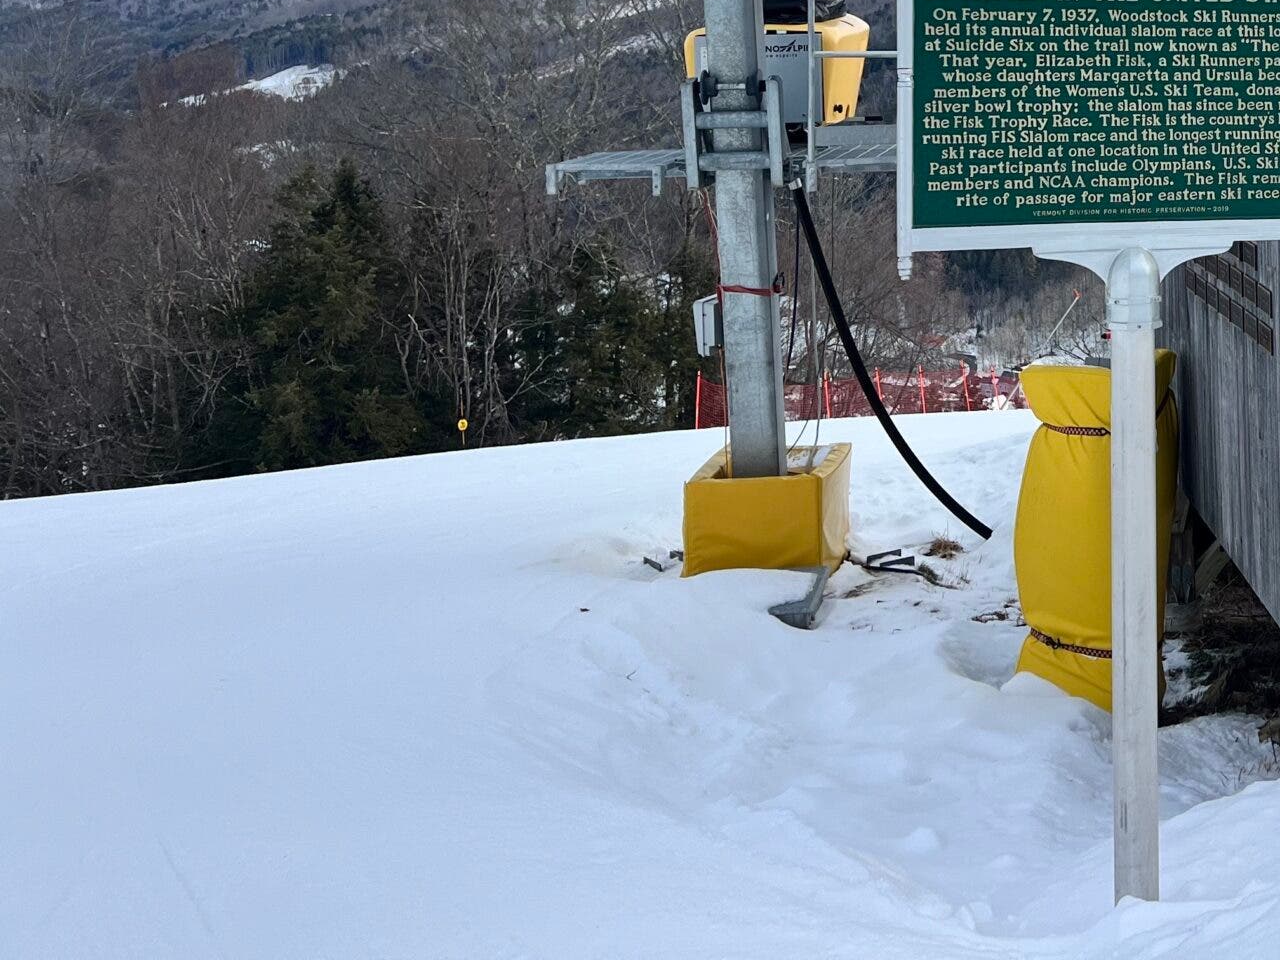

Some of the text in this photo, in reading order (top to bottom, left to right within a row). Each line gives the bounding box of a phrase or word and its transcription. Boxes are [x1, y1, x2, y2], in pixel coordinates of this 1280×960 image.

[933, 8, 956, 20] On
[961, 8, 1036, 24] February
[1042, 8, 1055, 22] 7,
[1061, 8, 1099, 23] 1937,
[1108, 9, 1188, 22] Woodstock
[1193, 9, 1216, 22] Ski
[1221, 10, 1280, 23] Runners
[924, 22, 960, 35] held
[965, 23, 986, 35] its
[991, 23, 1044, 36] annual
[1049, 23, 1126, 36] individual
[1131, 24, 1176, 37] slalom
[1181, 27, 1212, 36] race
[1217, 24, 1231, 36] at
[1237, 24, 1264, 37] this
[924, 38, 940, 50] at
[946, 38, 1004, 51] Suicide
[1009, 38, 1034, 51] Six
[1039, 42, 1057, 51] on
[1063, 38, 1088, 51] the
[1094, 38, 1129, 51] trail
[1134, 42, 1163, 51] now
[1169, 39, 1217, 51] known
[1222, 42, 1236, 51] as
[939, 53, 978, 66] That
[984, 57, 1026, 69] year,
[1035, 53, 1111, 66] Elizabeth
[1116, 54, 1151, 67] Fisk,
[1158, 57, 1166, 66] a
[1172, 54, 1195, 66] Ski
[1200, 54, 1259, 66] Runners
[942, 69, 991, 81] whose
[996, 68, 1075, 84] daughters
[1080, 68, 1168, 84] Margaretta
[1173, 68, 1201, 81] and
[1206, 68, 1252, 80] Ursula
[934, 85, 1006, 98] members
[1011, 84, 1028, 97] of
[1034, 84, 1060, 97] the
[1129, 84, 1157, 96] U.S.
[1164, 83, 1187, 96] Ski
[1193, 83, 1238, 97] Team,
[924, 99, 969, 112] silver
[974, 99, 1011, 112] bowl
[1087, 99, 1113, 111] the
[1117, 99, 1163, 111] slalom
[1167, 98, 1192, 111] has
[1195, 98, 1233, 111] since
[1237, 98, 1273, 110] been
[922, 115, 949, 128] the
[953, 115, 984, 128] Fisk
[988, 114, 1048, 131] Trophy
[1052, 113, 1092, 127] Race.
[1099, 113, 1129, 126] The
[1132, 113, 1161, 126] Fisk
[1165, 113, 1176, 125] is
[1180, 112, 1204, 125] the
[922, 131, 986, 147] running
[991, 130, 1016, 143] FIS
[1019, 129, 1069, 143] Slalom
[1073, 132, 1106, 142] race
[1109, 129, 1137, 141] and
[1141, 128, 1165, 140] the
[1168, 128, 1221, 143] longest
[1224, 127, 1280, 143] running
[941, 146, 964, 159] ski
[968, 148, 1004, 158] race
[1008, 144, 1042, 158] held
[1047, 145, 1063, 157] at
[1068, 147, 1095, 157] one
[1100, 143, 1159, 156] location
[1163, 143, 1177, 155] in
[1182, 142, 1207, 155] the
[1211, 141, 1260, 155] United
[929, 161, 963, 175] Past
[969, 160, 1066, 177] participants
[1071, 158, 1126, 172] include
[1132, 157, 1215, 174] Olympians,
[1223, 156, 1250, 169] U.S.
[1256, 156, 1278, 169] Ski
[927, 177, 999, 191] members
[1004, 175, 1033, 189] and
[1039, 174, 1085, 188] NCAA
[1090, 173, 1174, 190] champions.
[1183, 172, 1213, 185] The
[1218, 172, 1247, 184] Fisk
[956, 193, 987, 206] rite
[993, 192, 1009, 205] of
[1015, 193, 1075, 208] passage
[1081, 190, 1104, 203] for
[1109, 189, 1153, 205] major
[1158, 187, 1215, 201] eastern
[1220, 187, 1241, 199] ski
